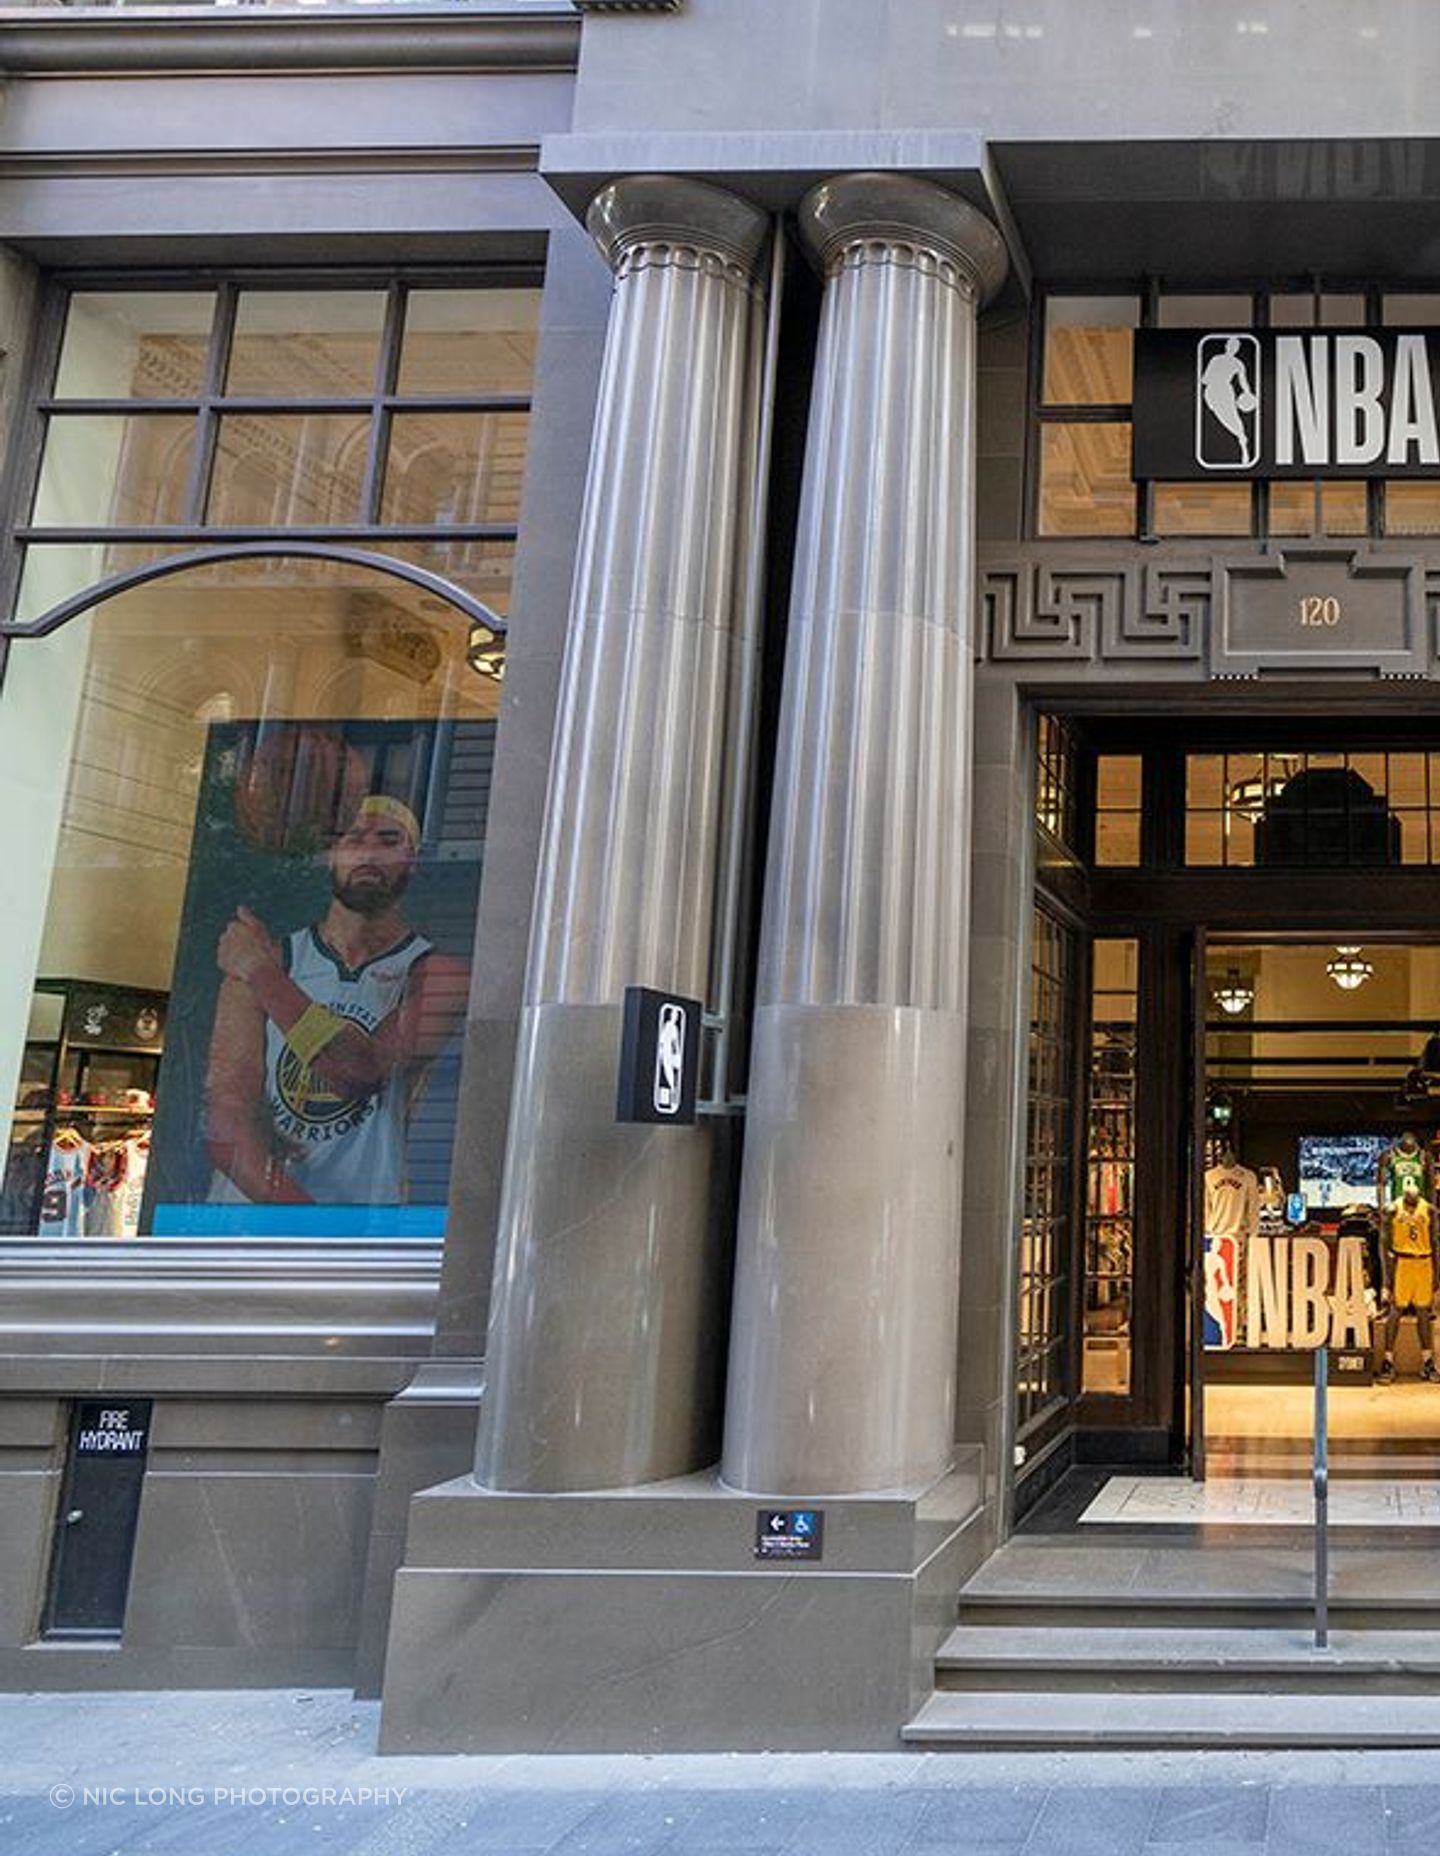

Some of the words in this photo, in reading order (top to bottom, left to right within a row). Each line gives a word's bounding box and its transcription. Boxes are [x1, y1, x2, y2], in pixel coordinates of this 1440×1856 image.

[1275, 335, 1440, 465] NBA
[1300, 597, 1340, 626] 120
[1247, 1237, 1371, 1349] NBA
[101, 1410, 129, 1429] FIRE
[80, 1431, 143, 1450] HYDRANT
